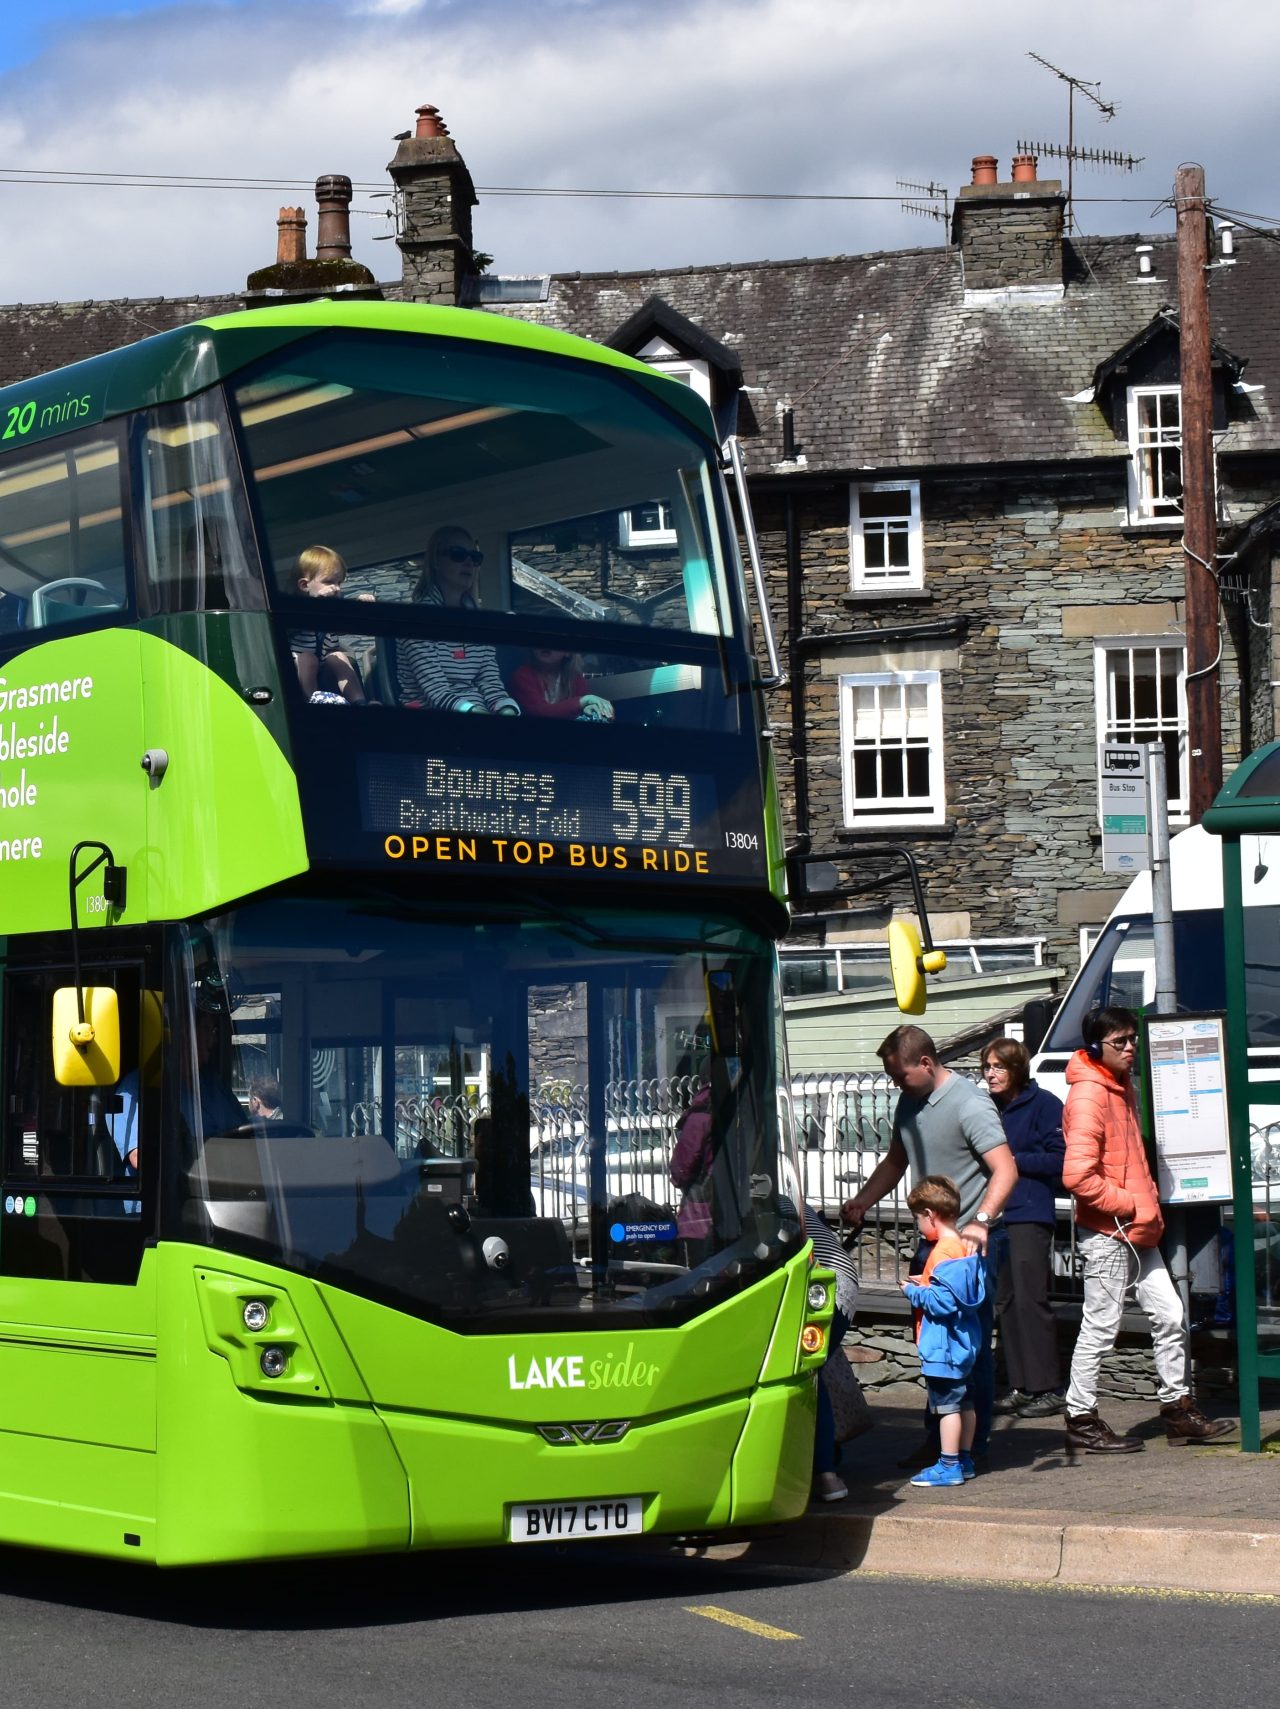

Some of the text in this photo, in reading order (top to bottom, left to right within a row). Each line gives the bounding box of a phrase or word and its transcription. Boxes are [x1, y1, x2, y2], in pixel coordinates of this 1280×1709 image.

[1, 401, 36, 440] 20
[40, 391, 91, 428] mins
[426, 758, 690, 842] Bowness 599
[1109, 783, 1136, 792] Bus Stop
[400, 798, 581, 837] Braithwaite Fold
[384, 835, 710, 873] OPEN TOP BUS RIDE
[725, 831, 759, 850] 13804
[526, 1502, 629, 1536] BV17 CTO
